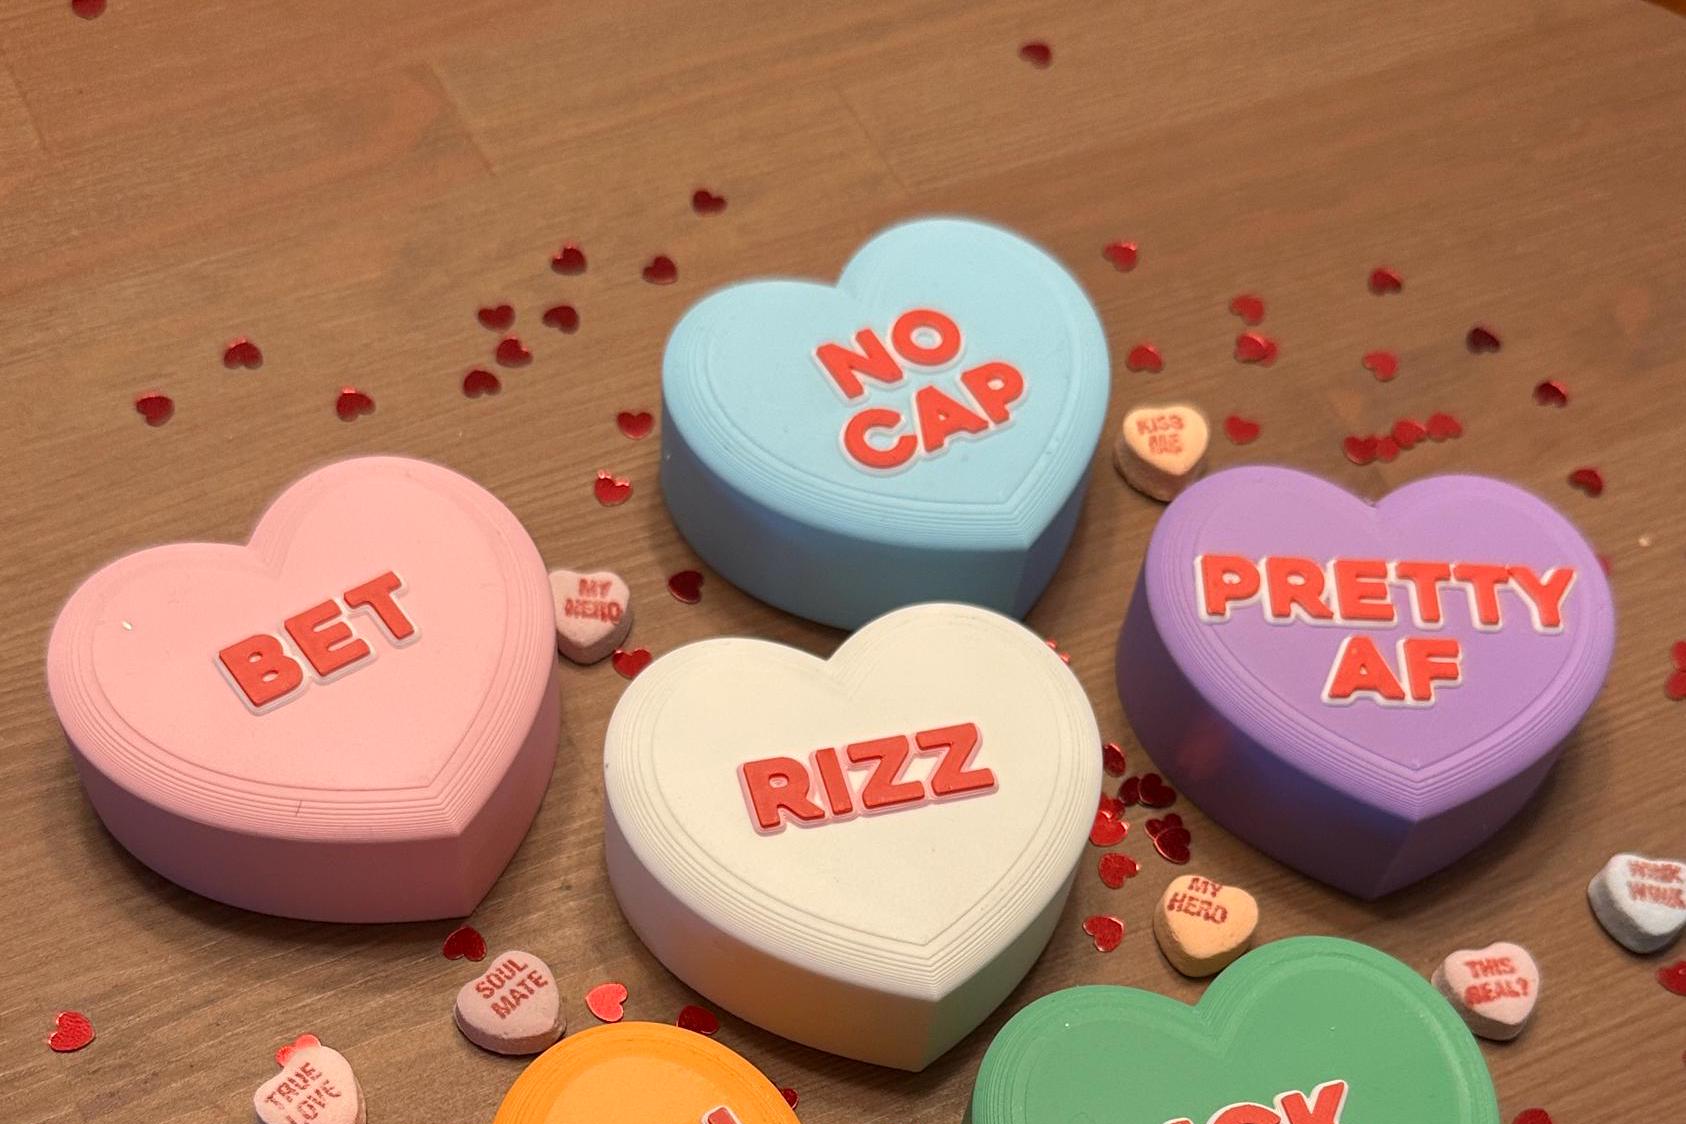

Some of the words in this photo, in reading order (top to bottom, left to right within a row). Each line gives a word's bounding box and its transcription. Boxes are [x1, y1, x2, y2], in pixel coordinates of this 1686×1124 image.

[814, 307, 965, 402] NO
[841, 360, 1029, 474] CAP
[579, 578, 612, 597] MY
[1199, 553, 1579, 632] PRETTY
[214, 568, 420, 712] BET
[1325, 634, 1464, 706] AF
[744, 720, 998, 833] RIZZ
[1167, 892, 1228, 924] HERO
[1188, 877, 1222, 897] MY
[475, 959, 528, 999] SOUL
[1464, 957, 1515, 978] THIS
[491, 969, 548, 1019] MATE
[265, 1062, 322, 1110] TRUE
